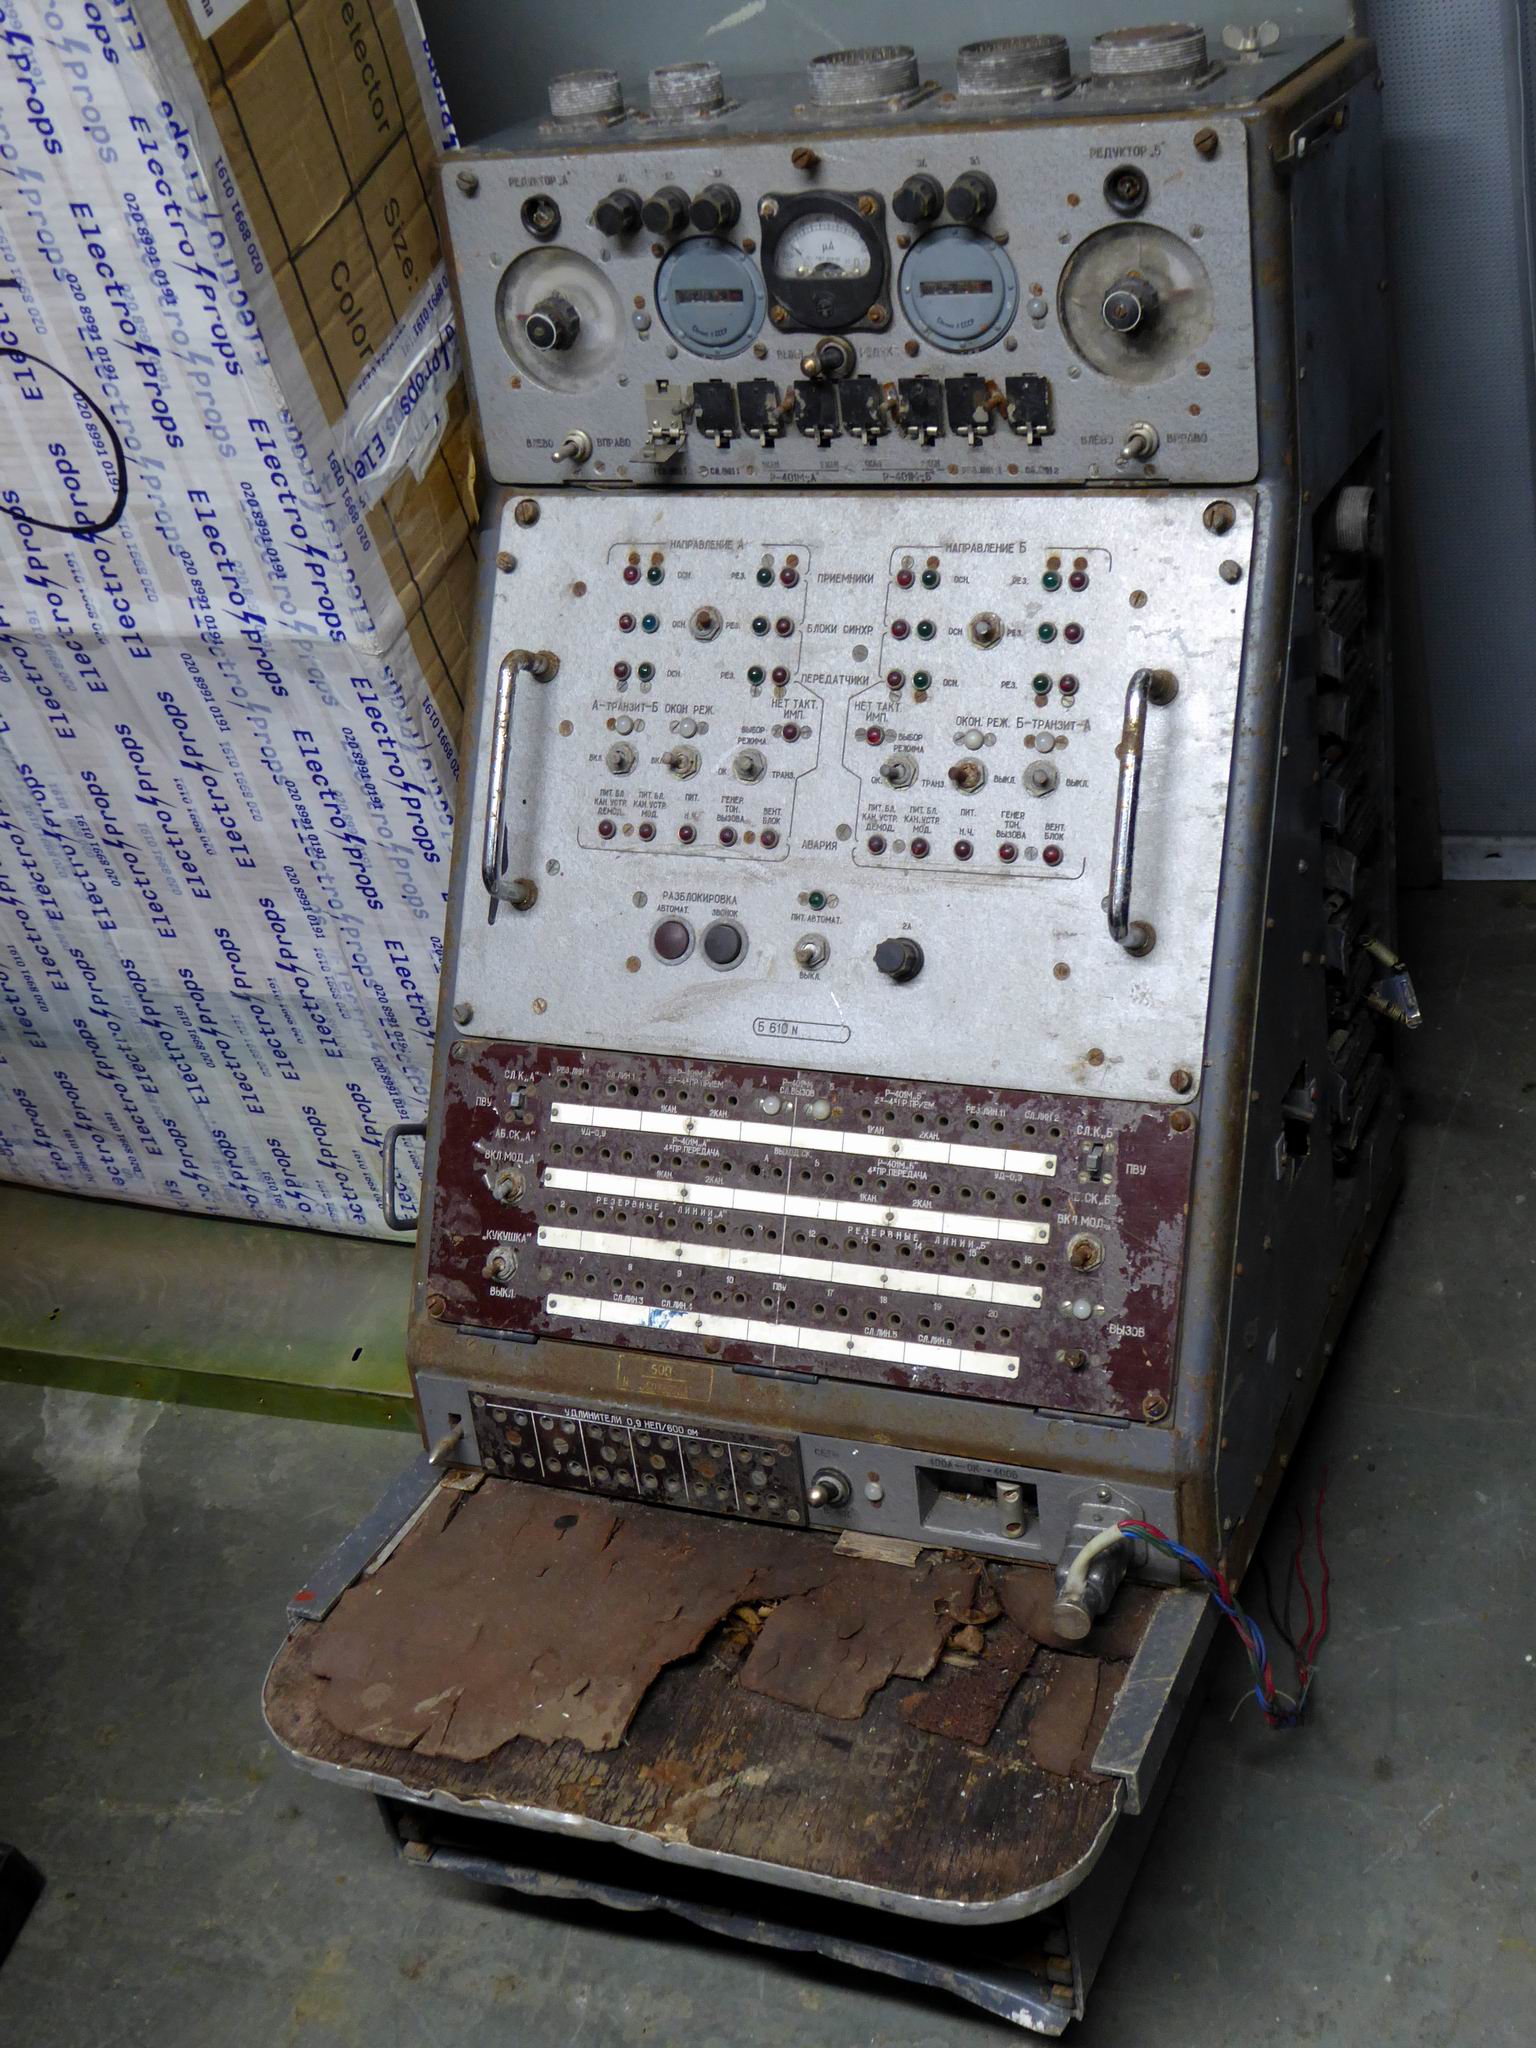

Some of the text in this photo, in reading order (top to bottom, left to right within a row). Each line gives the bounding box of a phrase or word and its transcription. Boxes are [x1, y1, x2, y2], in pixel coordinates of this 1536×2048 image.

[1088, 145, 1148, 160] РЕДУКТОР
[384, 197, 418, 292] Size:
[66, 273, 86, 301] 020
[331, 260, 374, 358] Color
[86, 423, 108, 457] 8991
[669, 539, 745, 551] НАПРАВЛЕНИЕ А
[945, 541, 1027, 554] НАПРАВЛЕНИЕ Б
[817, 572, 874, 585] ПРИЕМНИКИ
[806, 624, 838, 634] БЛОКИ
[800, 673, 870, 686] ПЕРЕДАТЧИКИ
[180, 653, 231, 733] 020 8991 0191
[591, 700, 659, 713] А-ТРАНЗИТ-Б
[770, 698, 790, 709] НЕТ
[854, 700, 873, 712] НЕТ
[865, 712, 889, 723] ИМП.
[740, 726, 766, 735] ВЫБОР
[737, 736, 768, 746] РЕЖИМА
[995, 829, 1027, 840] ВЫЗОВА
[1043, 831, 1065, 841] БЛОК
[801, 839, 838, 851] АВАРИЯ
[661, 890, 738, 906] РАЗБЛОКИРОВКА
[710, 908, 739, 919] ЗВОНОК
[475, 1096, 493, 1107] ПВУ
[1125, 1162, 1148, 1176] ПВУ
[725, 1275, 735, 1284] 10
[987, 1309, 999, 1319] 20
[1108, 1323, 1146, 1339] ВЫЗОВ
[563, 1406, 623, 1426] УДЛИНИТЕЛИ
